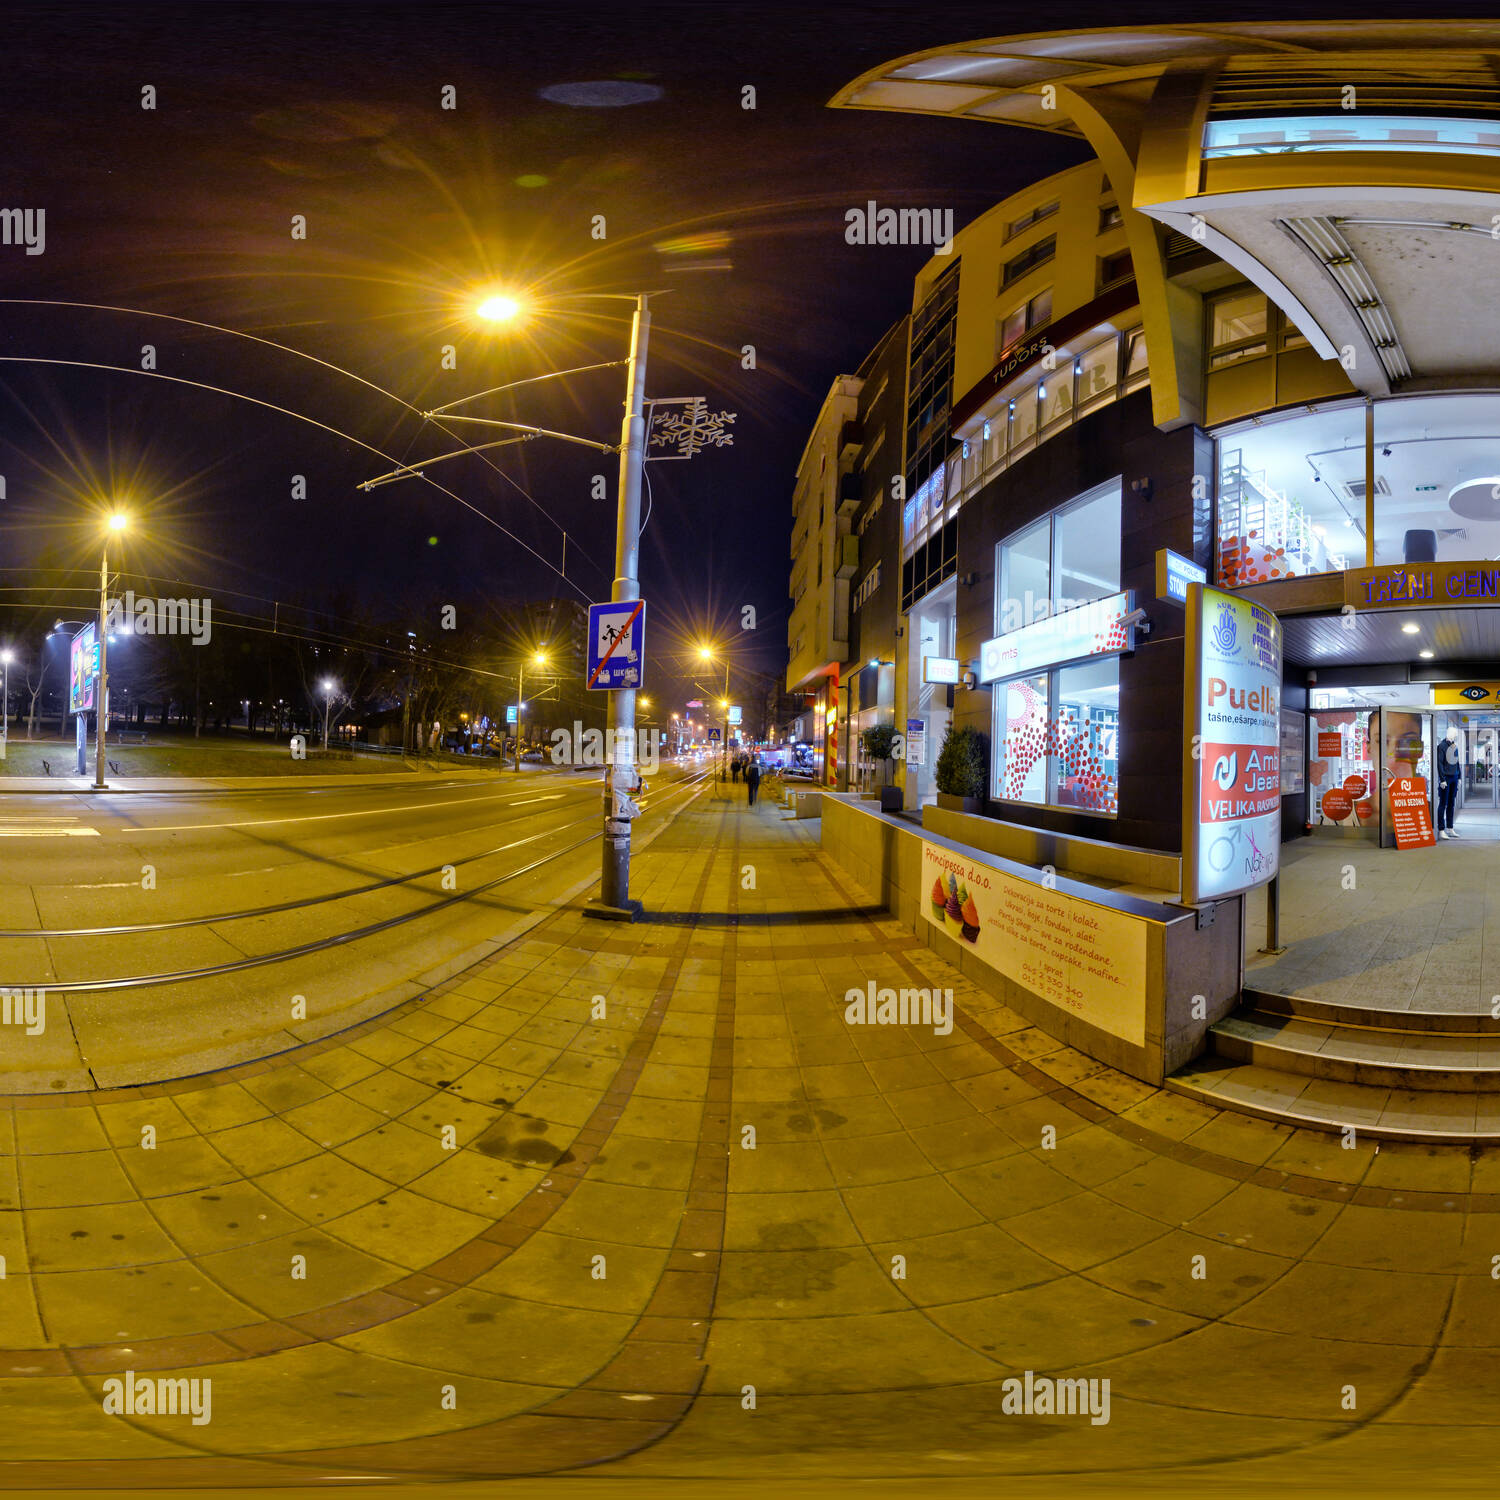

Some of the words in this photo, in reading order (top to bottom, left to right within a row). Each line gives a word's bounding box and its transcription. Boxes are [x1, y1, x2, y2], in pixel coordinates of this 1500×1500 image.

[993, 337, 1048, 384] TUDORS
[1360, 569, 1433, 603] TRŽNI
[1001, 647, 1018, 660] mts
[931, 663, 955, 677] mts
[1207, 677, 1277, 717] Puella
[1244, 772, 1279, 793] Jeans
[1208, 799, 1256, 821] VELIKA
[1394, 799, 1407, 807] NOVA
[1407, 798, 1425, 806] SEZONA
[925, 847, 965, 877] Principessa
[967, 869, 992, 890] d.o.o.
[1003, 886, 1034, 905] Dekoracija
[1046, 904, 1065, 918] torte
[998, 909, 1015, 925] Party
[1054, 936, 1063, 945] za
[1045, 916, 1074, 936] fondan,
[1044, 964, 1064, 978] sprat
